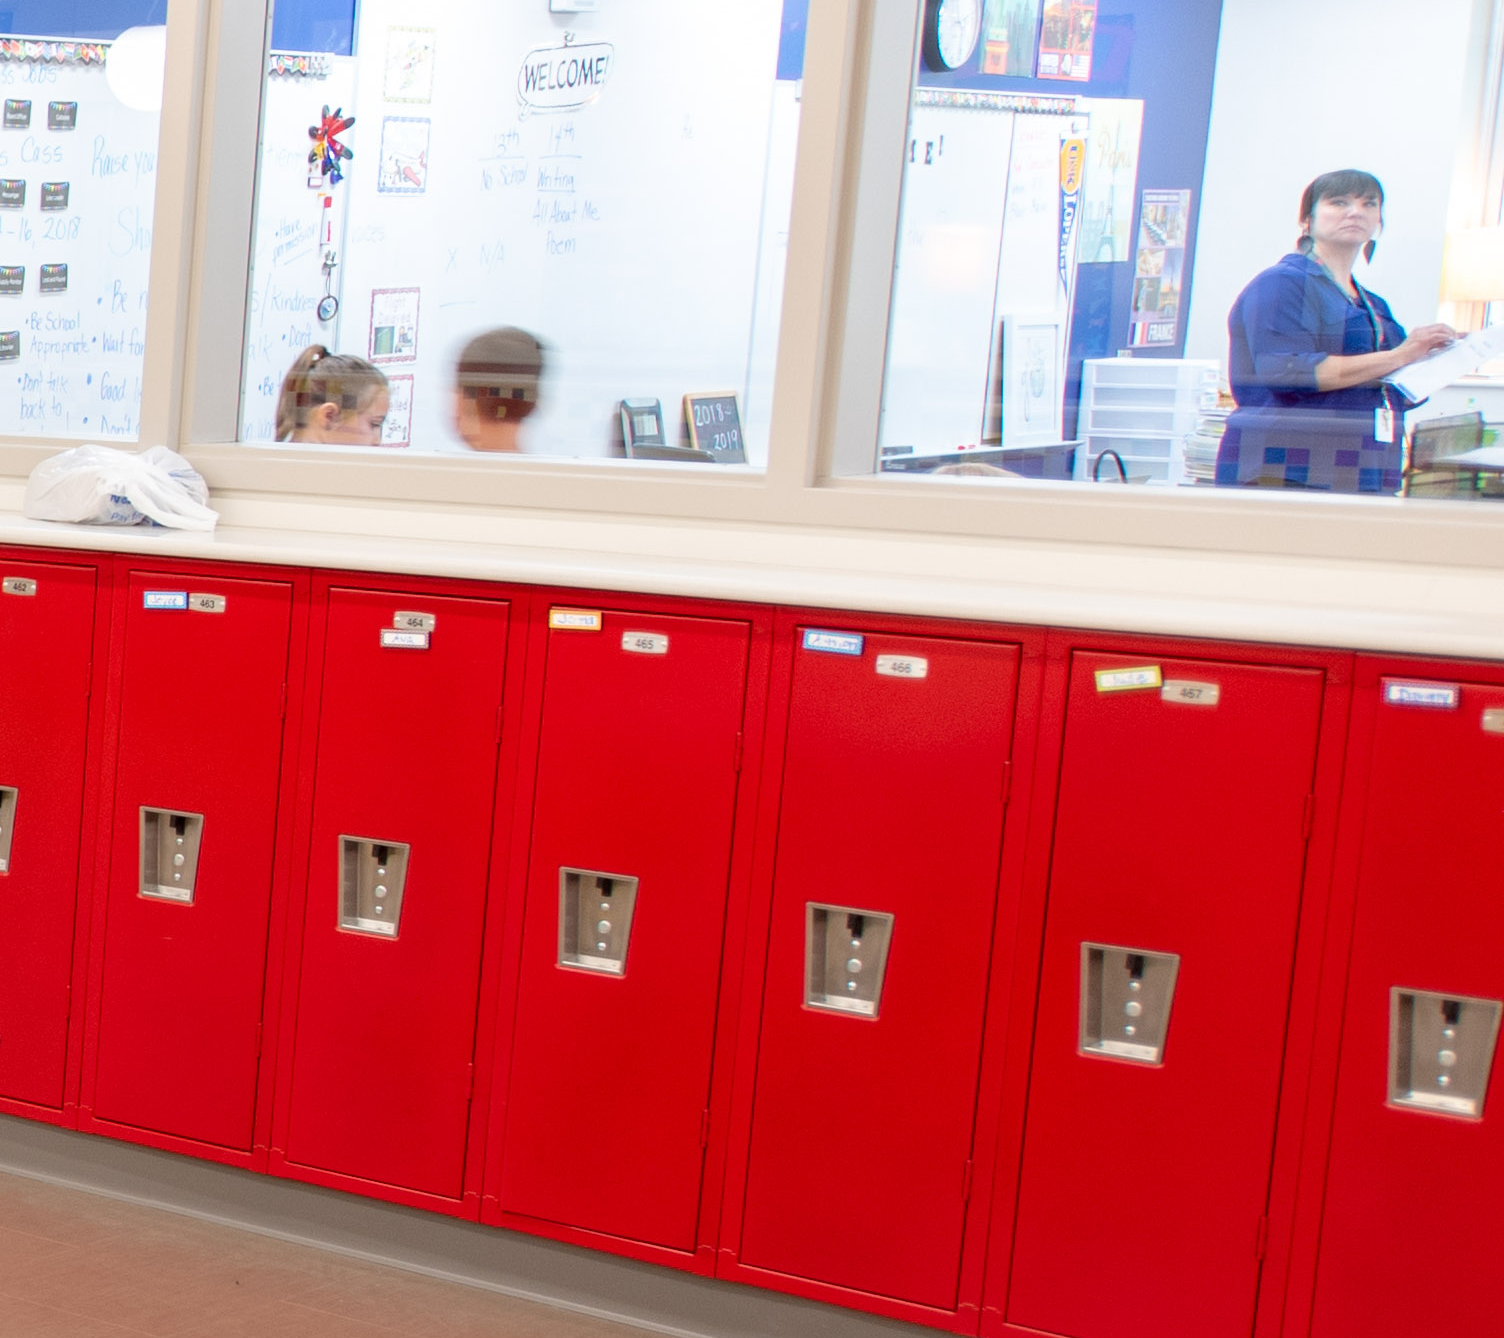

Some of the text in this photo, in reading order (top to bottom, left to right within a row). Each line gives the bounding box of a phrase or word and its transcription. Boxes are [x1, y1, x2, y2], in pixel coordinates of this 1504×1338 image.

[525, 55, 610, 93] WELCOME!
[42, 215, 82, 240] 2018
[45, 310, 80, 330] School
[713, 429, 739, 451] 2019
[199, 599, 215, 609] 463
[406, 618, 424, 628] 464
[635, 638, 654, 650] 465
[890, 662, 913, 674] 466
